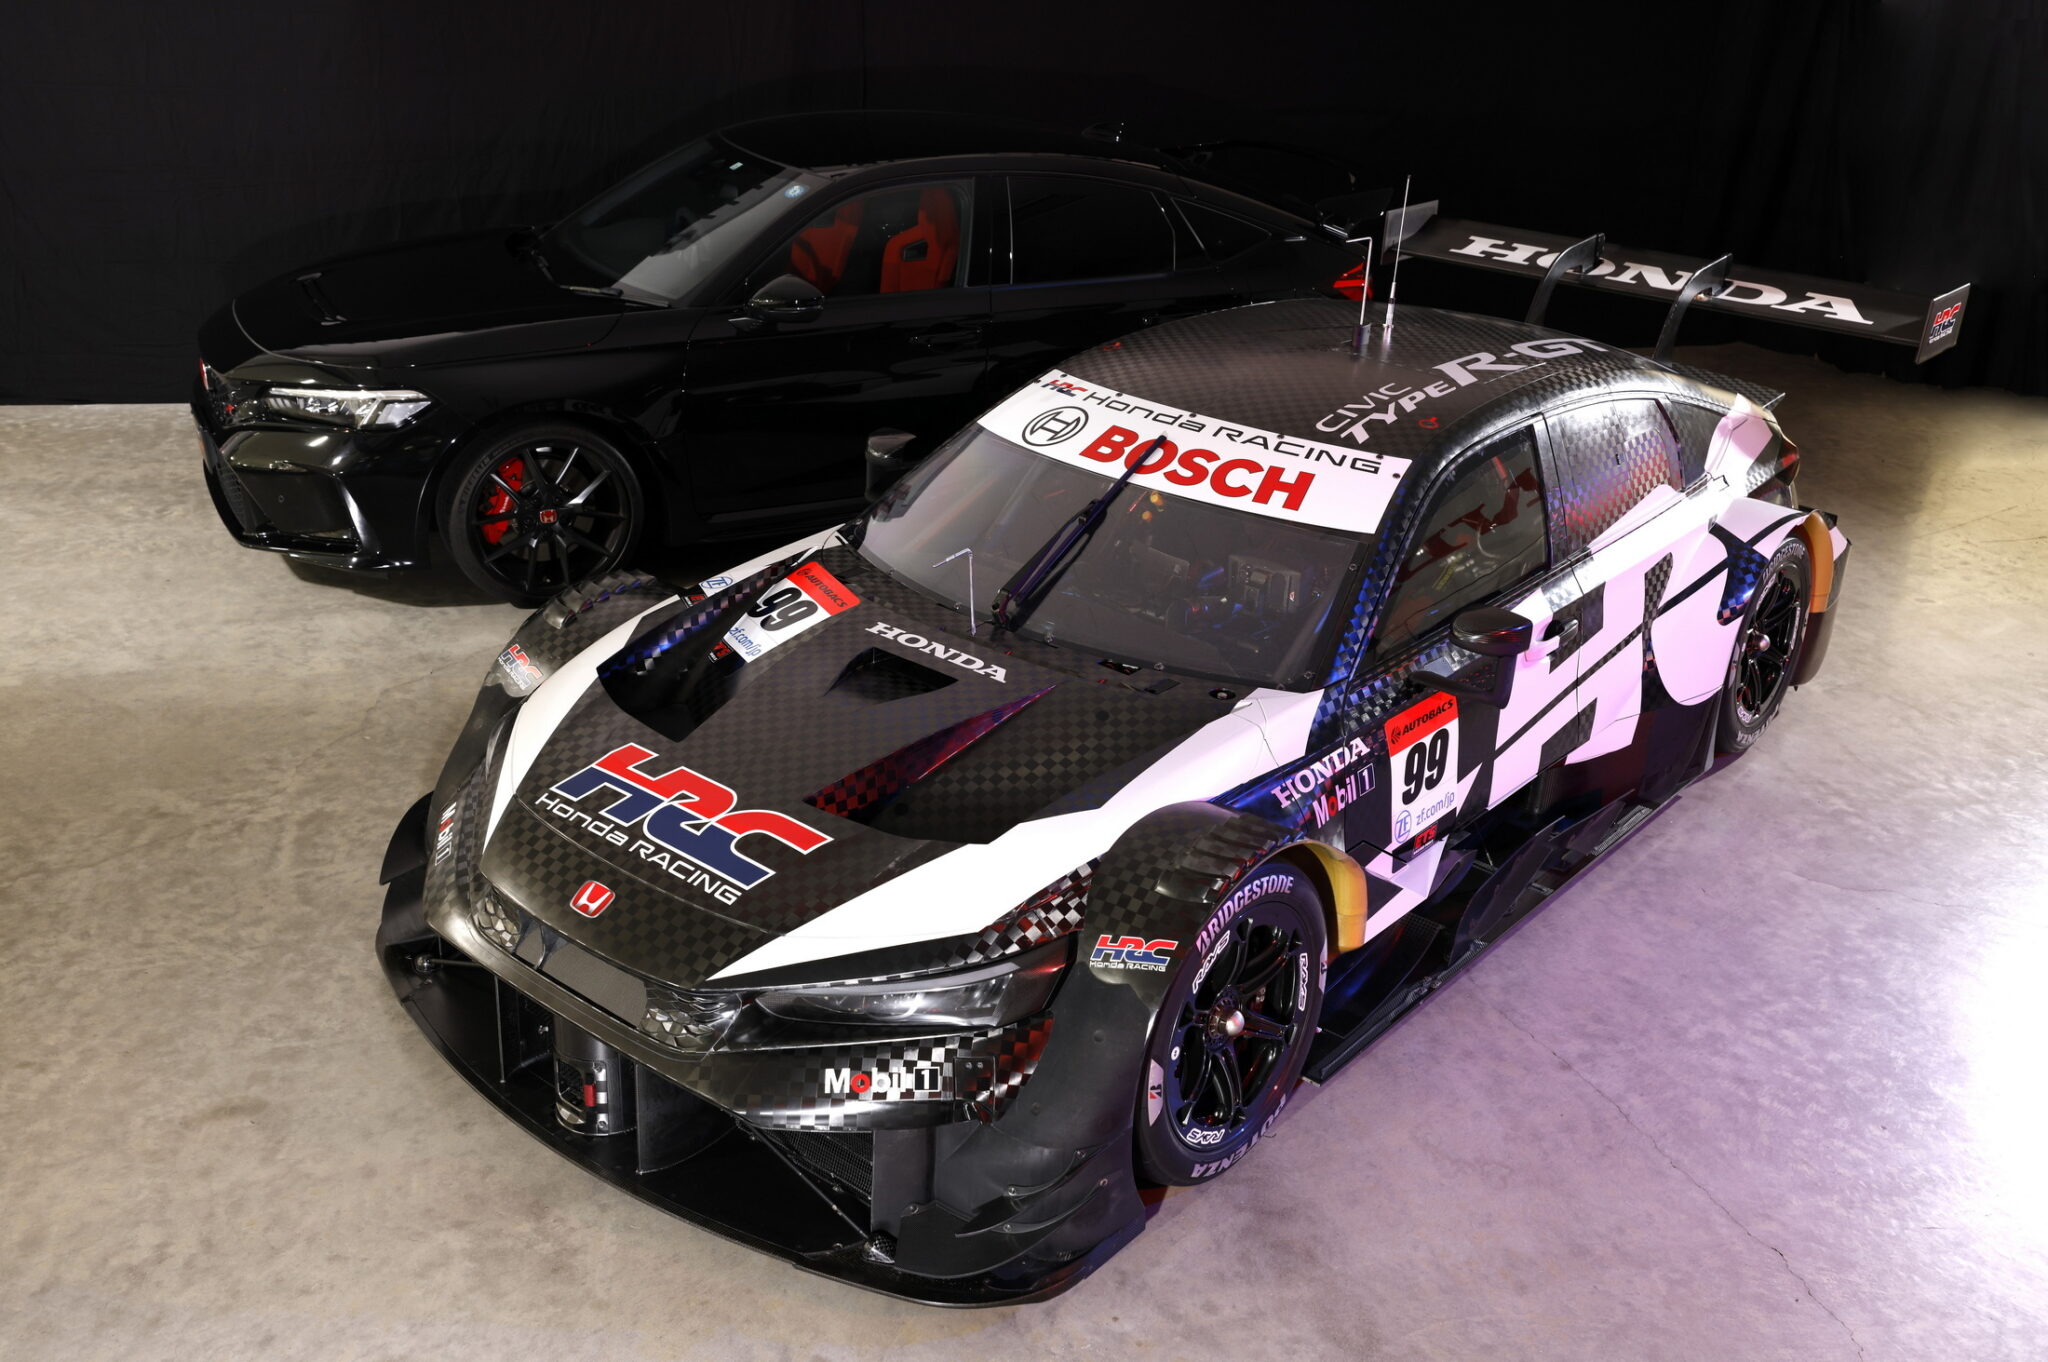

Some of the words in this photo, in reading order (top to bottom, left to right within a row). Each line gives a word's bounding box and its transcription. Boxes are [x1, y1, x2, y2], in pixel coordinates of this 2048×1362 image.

[1449, 235, 1873, 325] HONDA
[1041, 379, 1088, 397] HRC
[1083, 391, 1206, 432] Honda
[1212, 426, 1384, 474] RACING
[1315, 382, 1412, 433] CIVIC
[1340, 380, 1456, 444] TYPE
[1079, 425, 1315, 511] BOSCH
[747, 587, 818, 632] 99
[806, 573, 848, 608] AUTOBACS
[729, 627, 761, 656] zf.com/jp
[865, 621, 1007, 683] HONDA
[1401, 699, 1454, 737] AUTOBACS
[1270, 736, 1371, 809] HONDA
[1401, 728, 1450, 805] 99
[550, 742, 835, 891] HRC
[1312, 775, 1357, 829] Mobil
[1396, 812, 1411, 841] ZF
[1416, 792, 1455, 825] zf.com/jp
[535, 793, 629, 846] Honda
[628, 839, 742, 906] RACING
[1195, 873, 1295, 953] BRIDGESTONE
[1090, 934, 1179, 966] HRC
[1090, 960, 1124, 969] Honda
[1126, 963, 1166, 972] RACING
[824, 1067, 908, 1094] Mobil
